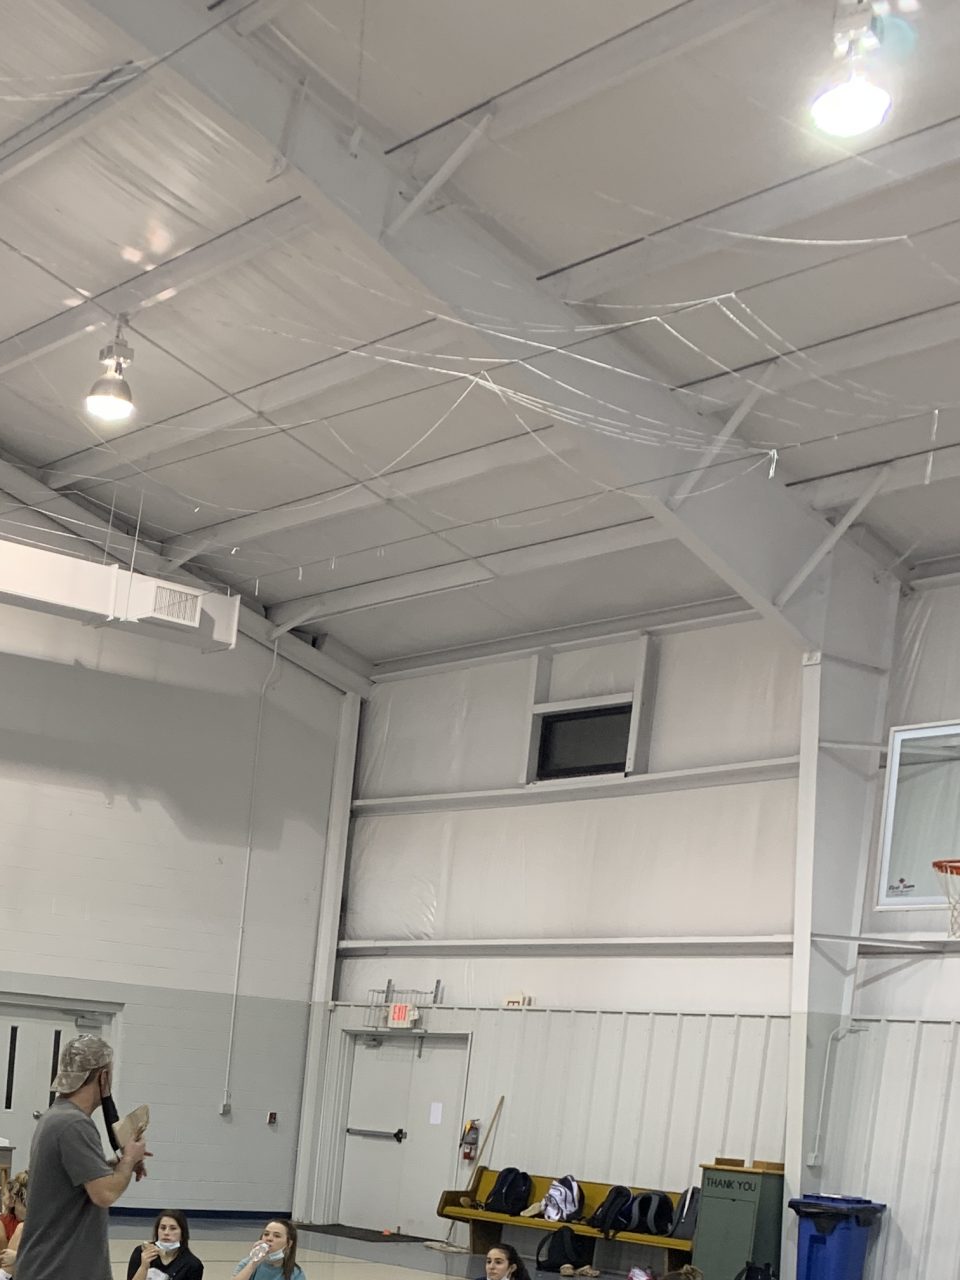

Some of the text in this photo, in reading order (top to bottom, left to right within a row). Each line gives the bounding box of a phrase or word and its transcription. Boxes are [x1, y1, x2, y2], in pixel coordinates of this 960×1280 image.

[392, 1004, 408, 1021] EXIT
[706, 1177, 757, 1192] THANK YOU
